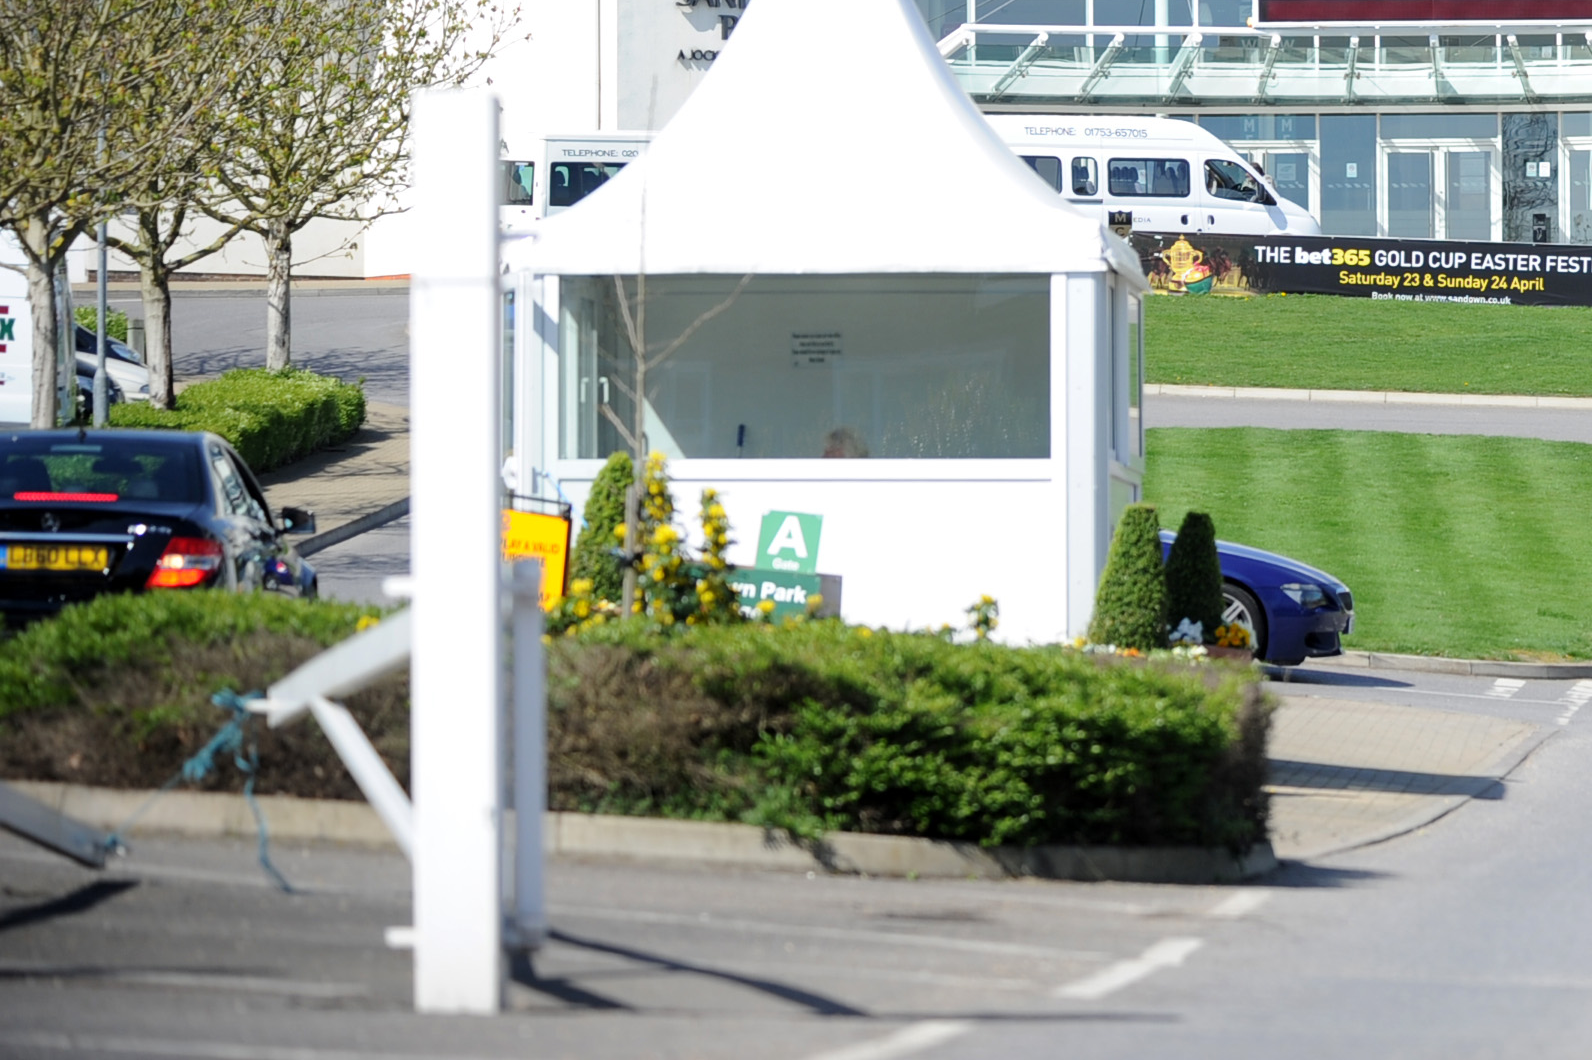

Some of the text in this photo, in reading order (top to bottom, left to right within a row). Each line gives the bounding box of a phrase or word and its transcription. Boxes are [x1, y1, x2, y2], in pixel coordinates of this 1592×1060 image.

[1024, 126, 1148, 138] TELEPHONE: 01753-657015
[562, 148, 619, 158] TELEPHONE:
[1254, 245, 1291, 264] THE
[1295, 246, 1371, 267] bet365
[1374, 249, 1425, 268] GOLD
[1428, 251, 1467, 270] CUP
[1470, 252, 1541, 272] EASTER
[1339, 270, 1545, 294] Saturday 23 & Sunday 24 April
[1371, 291, 1511, 305] Book now at www.sandown.co.uk
[766, 515, 808, 558] A
[760, 580, 807, 604] Park
